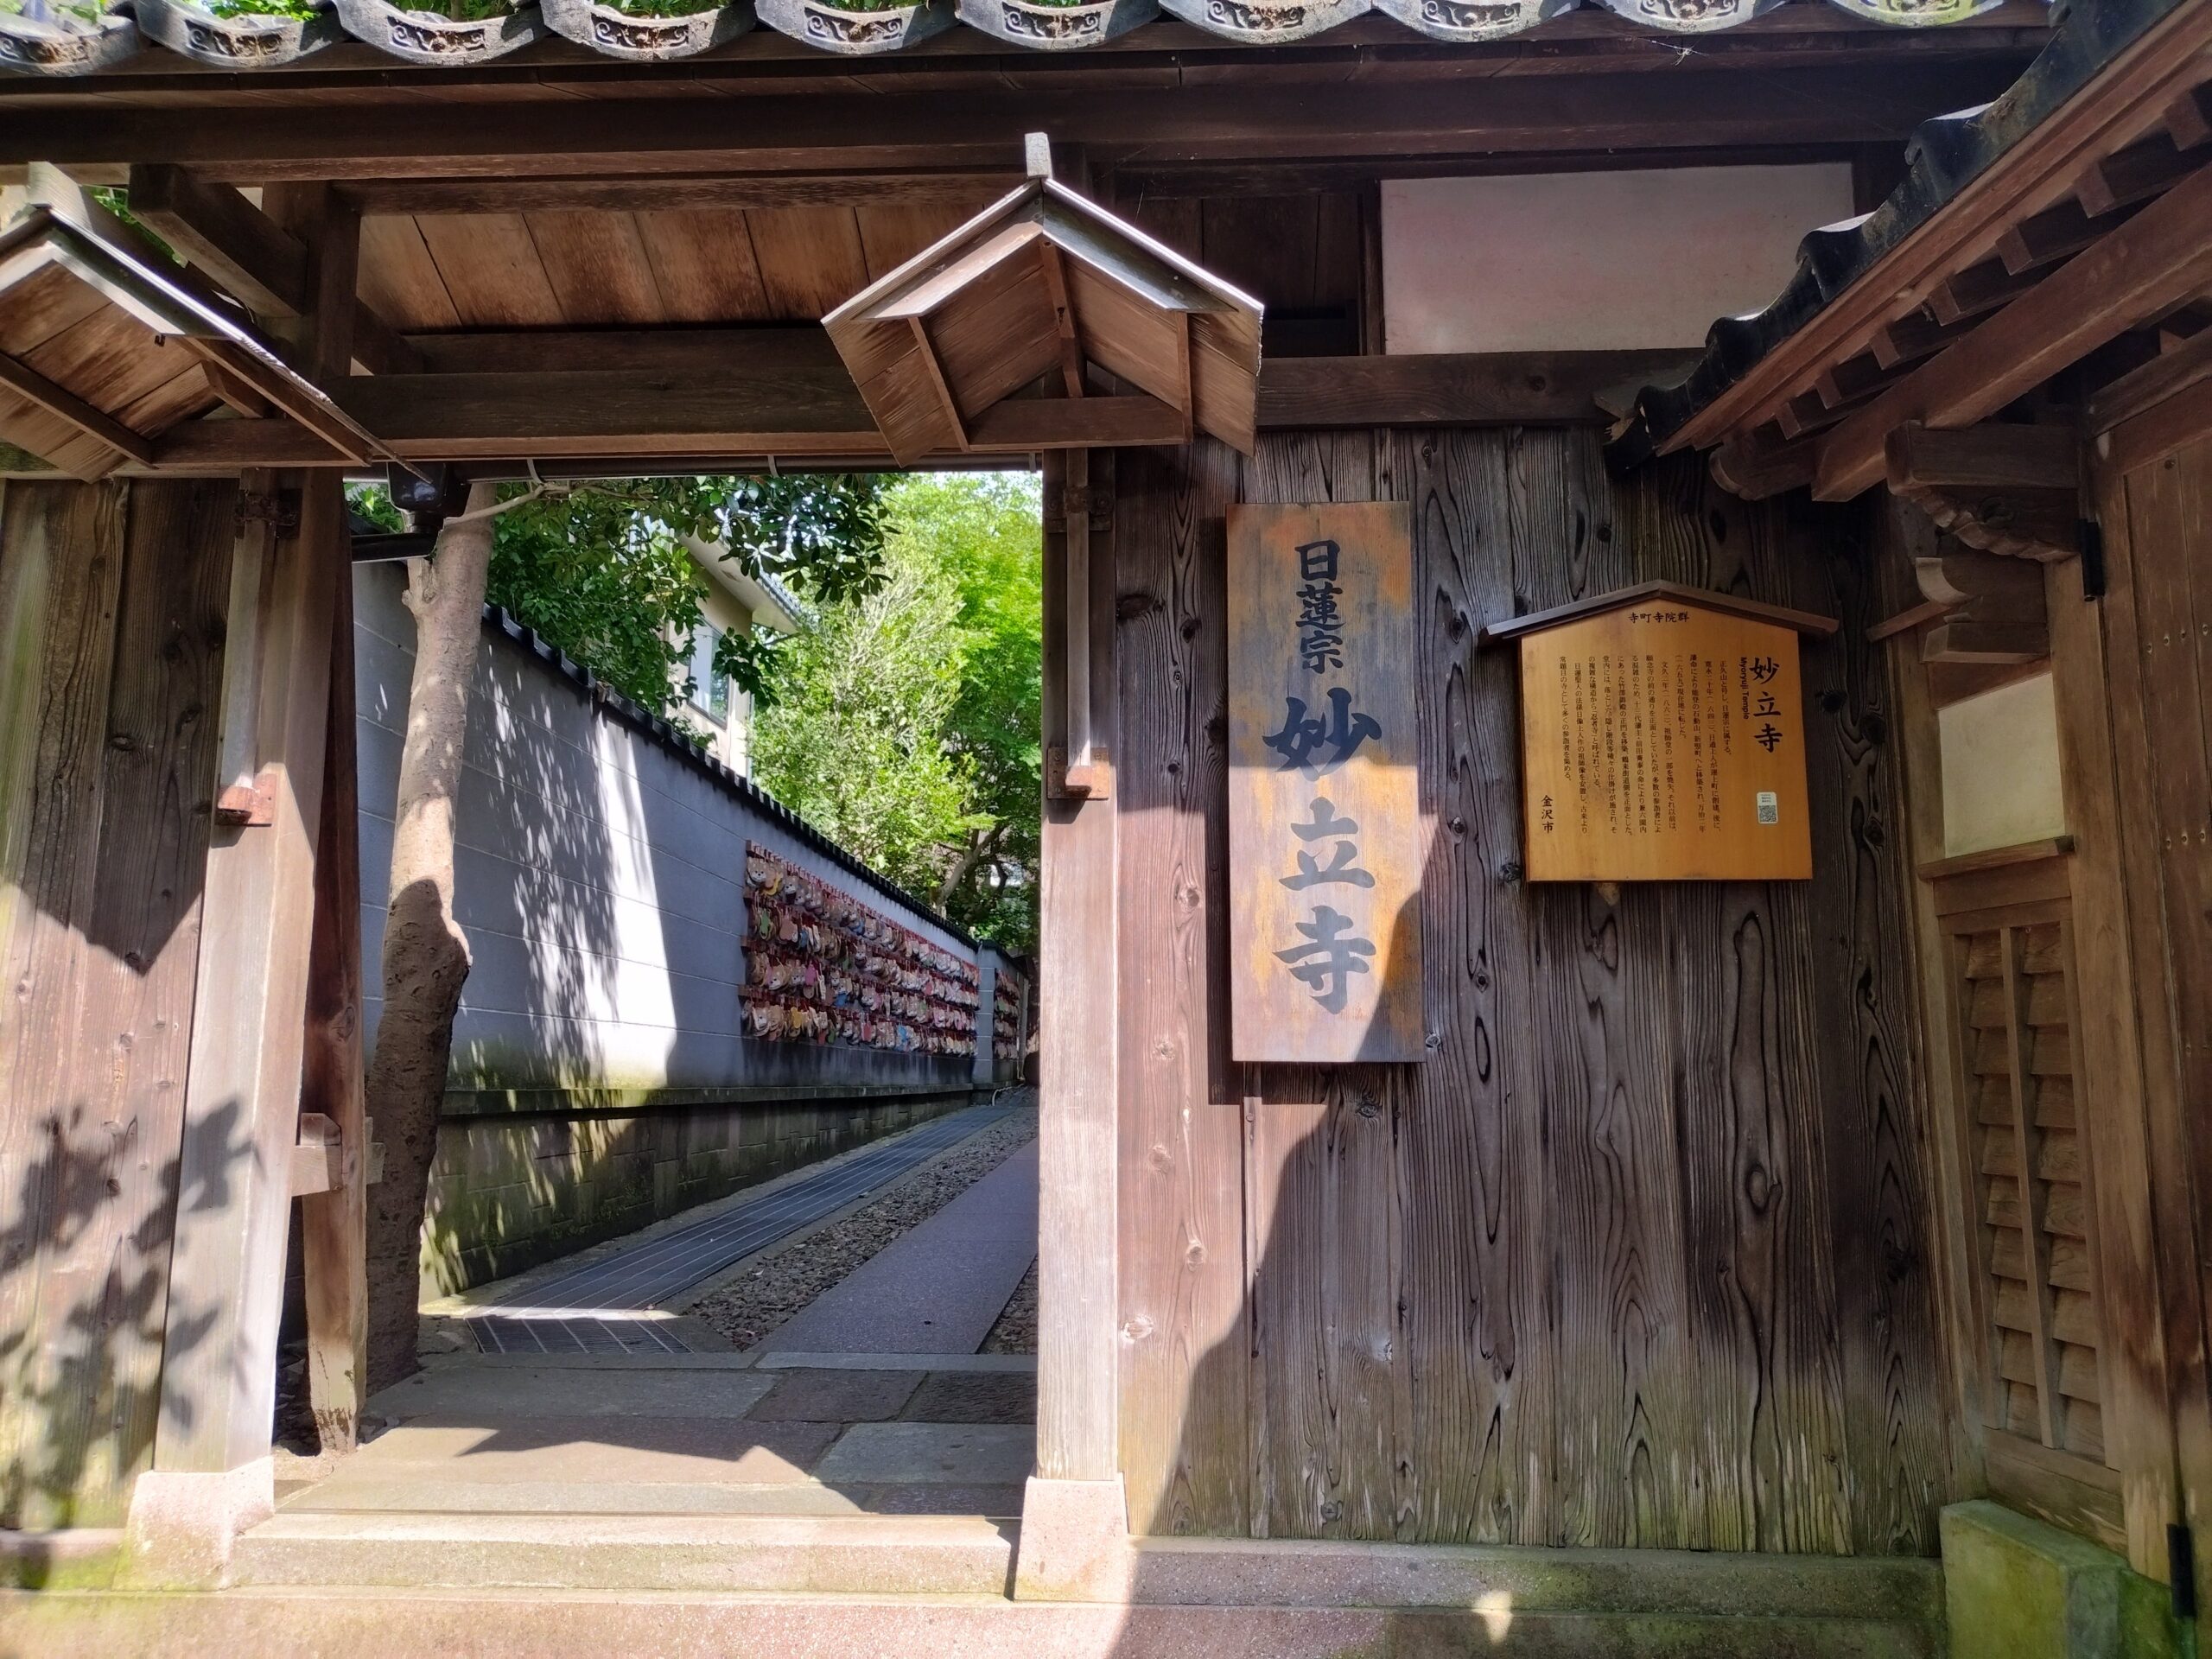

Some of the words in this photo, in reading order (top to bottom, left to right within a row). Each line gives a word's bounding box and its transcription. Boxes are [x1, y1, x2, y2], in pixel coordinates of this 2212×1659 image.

[1294, 538, 1346, 675] 日蓮宗
[1628, 611, 1690, 623] 寺町寺院群
[1750, 657, 1783, 753] 妙立寺
[1263, 686, 1383, 1015] 妙立寺
[1541, 795, 1554, 833] 金沢市
